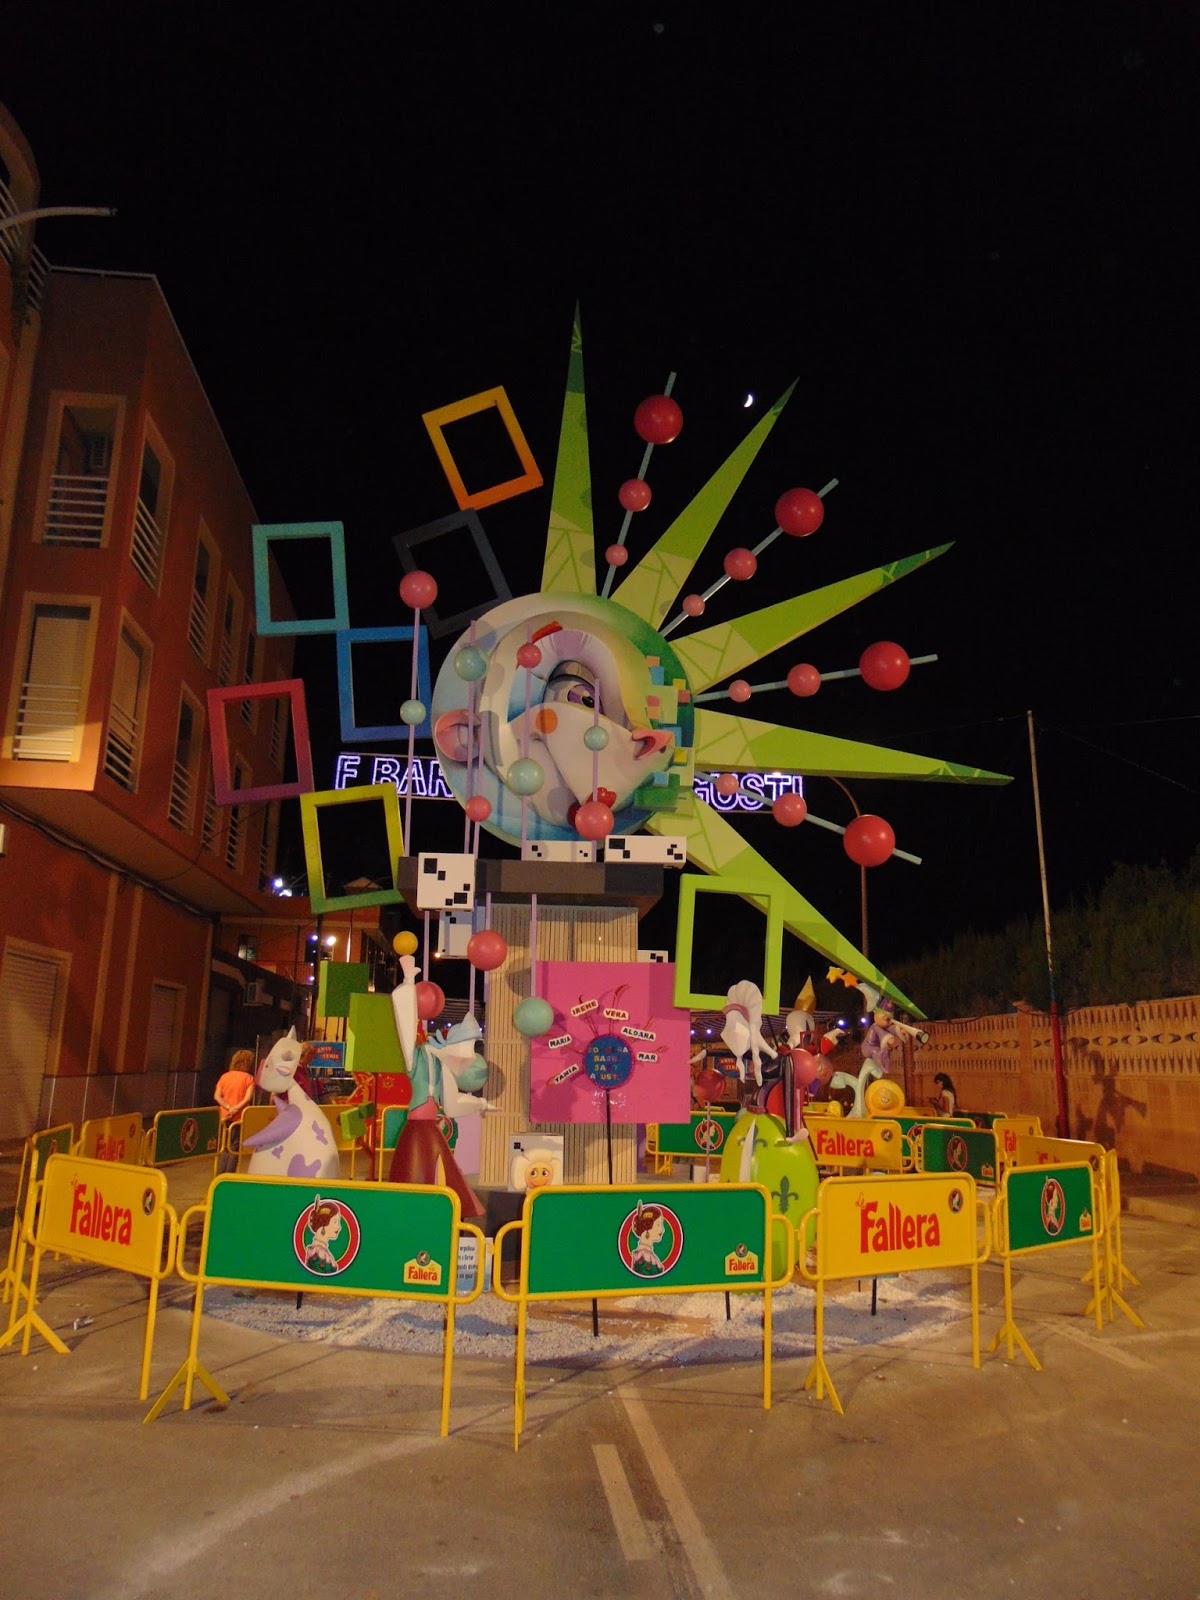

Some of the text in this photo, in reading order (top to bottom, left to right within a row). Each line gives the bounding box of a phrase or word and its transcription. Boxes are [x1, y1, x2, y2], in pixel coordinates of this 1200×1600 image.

[605, 1010, 627, 1019] VERA
[622, 1027, 655, 1040] ALDARA
[550, 1036, 571, 1047] MARIA
[638, 1053, 656, 1061] MAR
[554, 1066, 578, 1083] TANIA
[816, 1130, 875, 1158] Fallera
[69, 1184, 132, 1246] Fallera
[860, 1201, 941, 1254] Fallera
[729, 1258, 755, 1271] Fallera
[408, 1266, 438, 1281] Fallera
